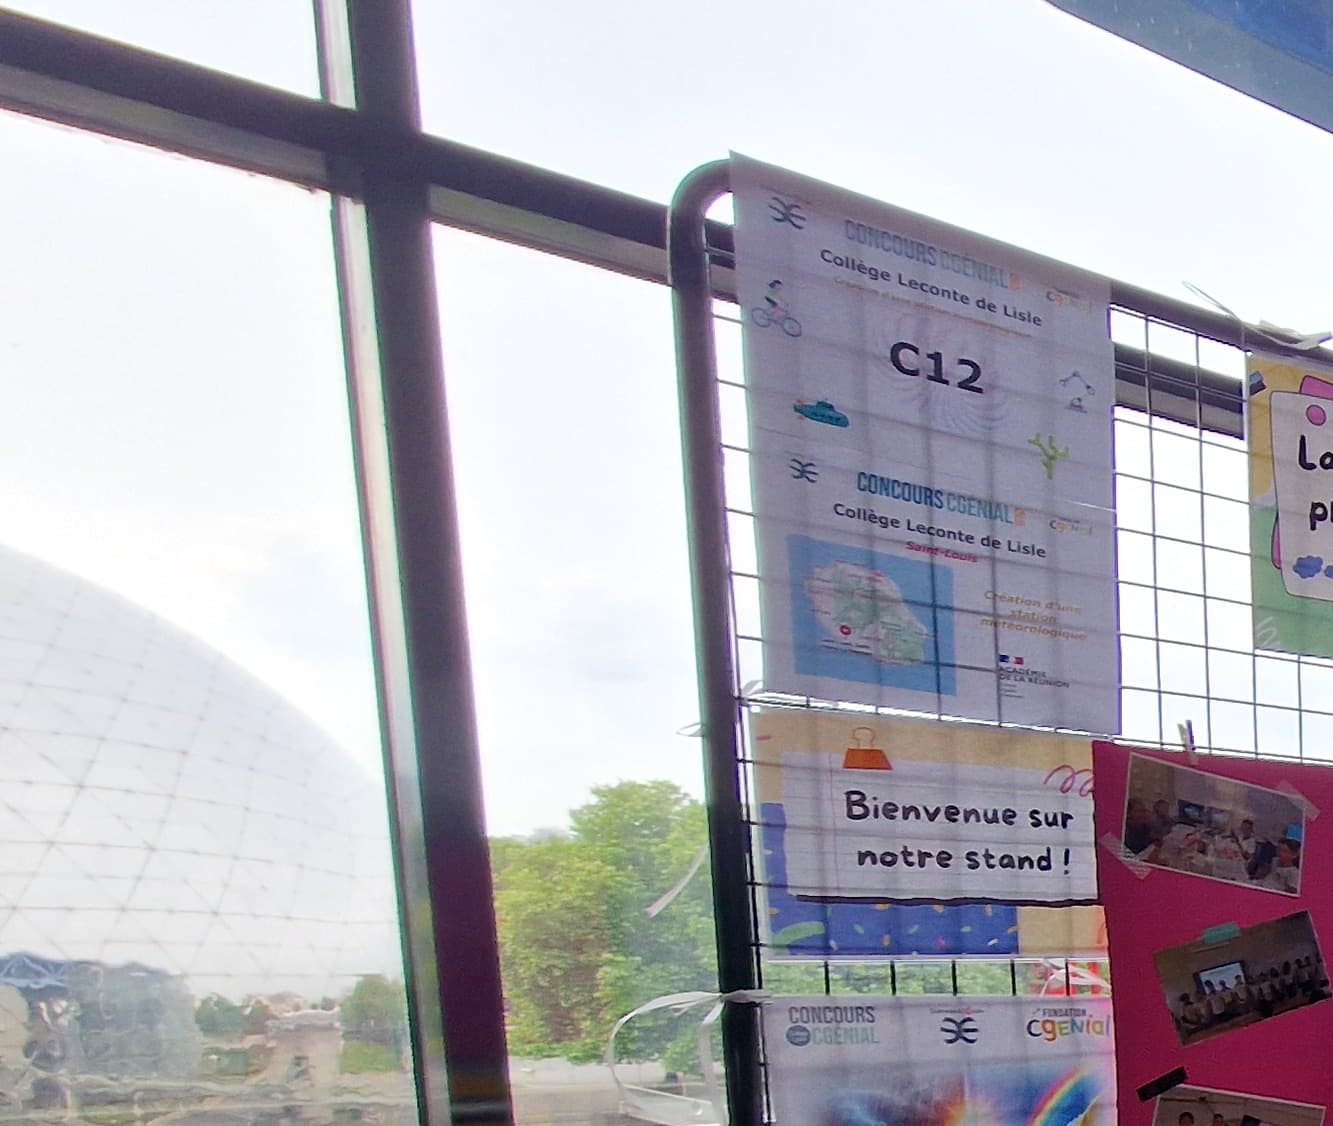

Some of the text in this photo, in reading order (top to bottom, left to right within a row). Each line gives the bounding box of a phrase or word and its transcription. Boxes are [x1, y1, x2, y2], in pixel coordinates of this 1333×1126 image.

[820, 248, 892, 283] Collège
[898, 271, 970, 306] Leconte
[976, 295, 998, 314] de
[1003, 302, 1043, 327] Lisle
[889, 340, 986, 395] C12
[857, 470, 945, 510] CONCOURS
[833, 502, 1047, 559] Collège Leconte de Lisle
[905, 540, 979, 564] Saint-Louis
[844, 790, 1074, 830] Bienvenue sur
[857, 846, 1071, 876] notre stand !
[788, 1005, 876, 1025] CONCOURS
